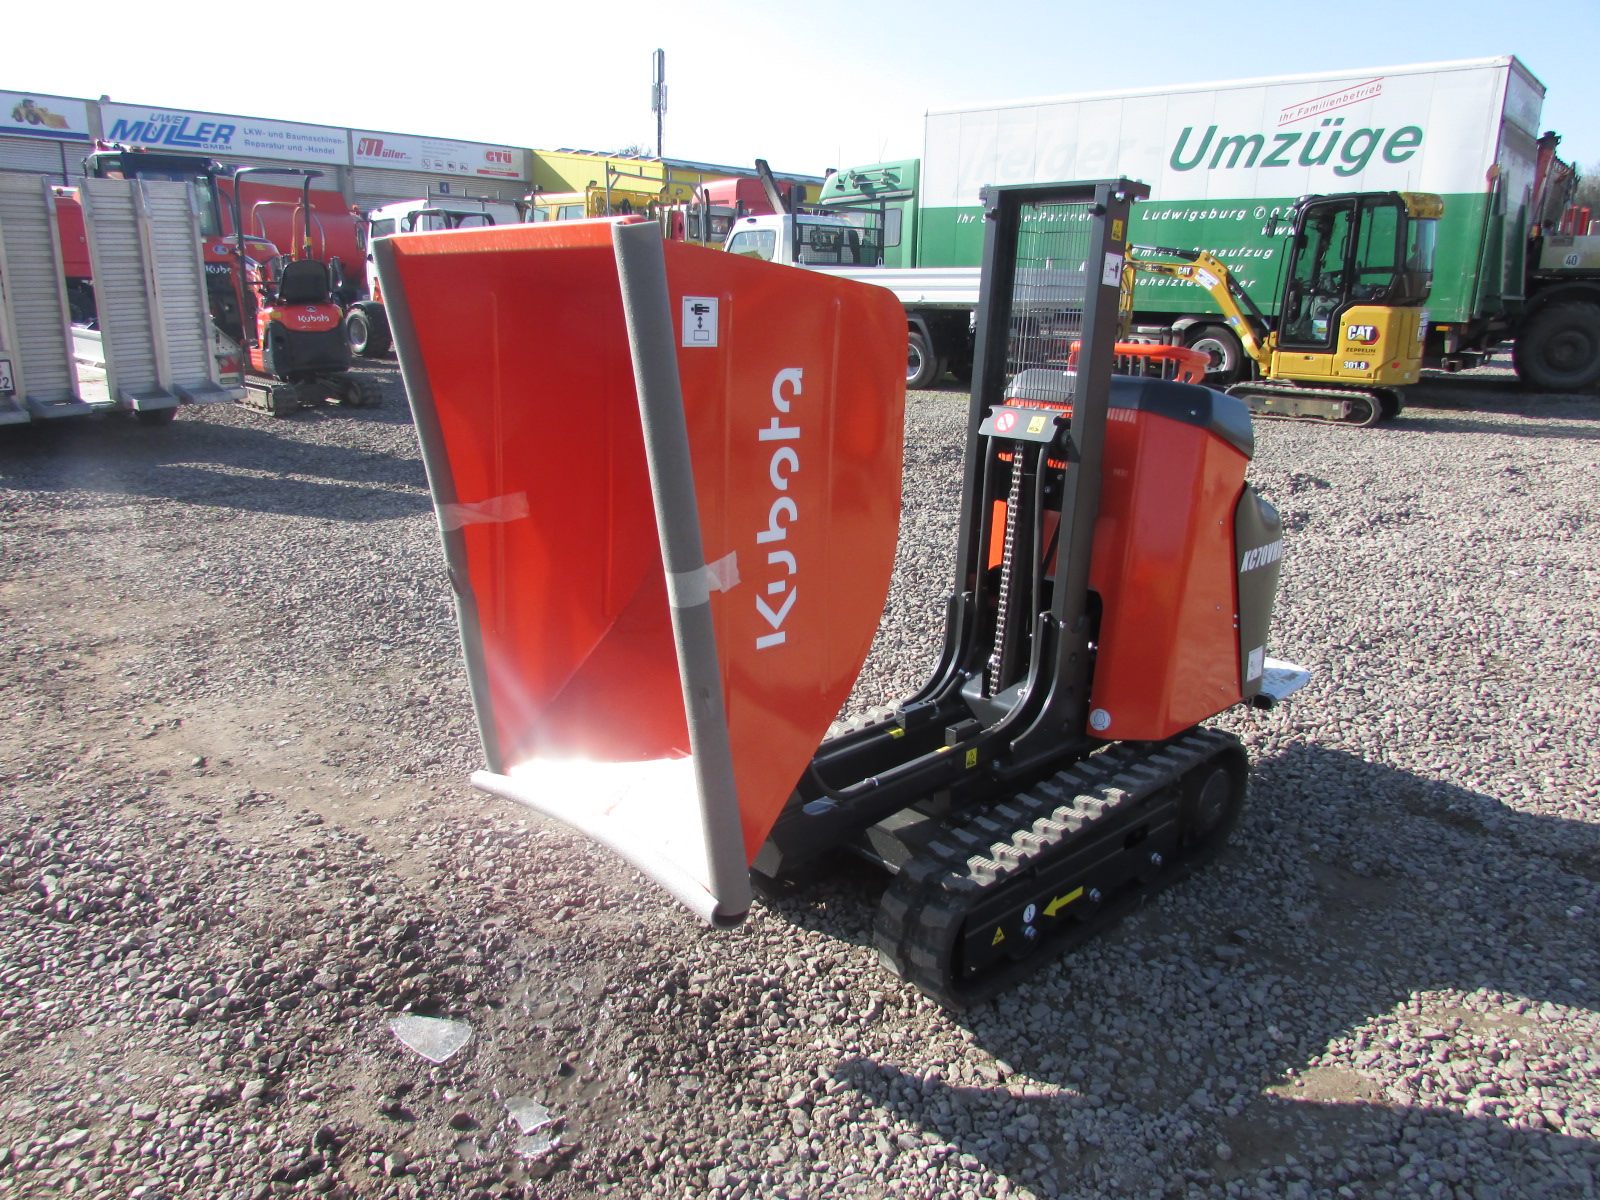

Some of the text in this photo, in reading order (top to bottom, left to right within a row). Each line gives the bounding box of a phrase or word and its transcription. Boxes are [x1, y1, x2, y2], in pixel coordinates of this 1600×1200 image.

[1279, 84, 1383, 122] Ihr Familienbetrieb
[149, 113, 183, 125] UWE
[108, 116, 236, 148] MÜLLER
[243, 127, 345, 145] LKW- und Baumaschinen-
[202, 143, 233, 151] GMBH
[244, 139, 335, 155] Reparatur und -Handel
[1169, 117, 1424, 177] Umzüge
[486, 150, 512, 164] GTÜ
[957, 213, 976, 223] Ihr
[1142, 208, 1247, 221] Ludwigsburg
[1565, 255, 1578, 266] 40
[1177, 266, 1191, 276] CAT
[297, 314, 330, 323] Kubota
[1347, 325, 1374, 341] CAT
[1343, 361, 1366, 370] 301.8
[755, 367, 803, 650] Kubota
